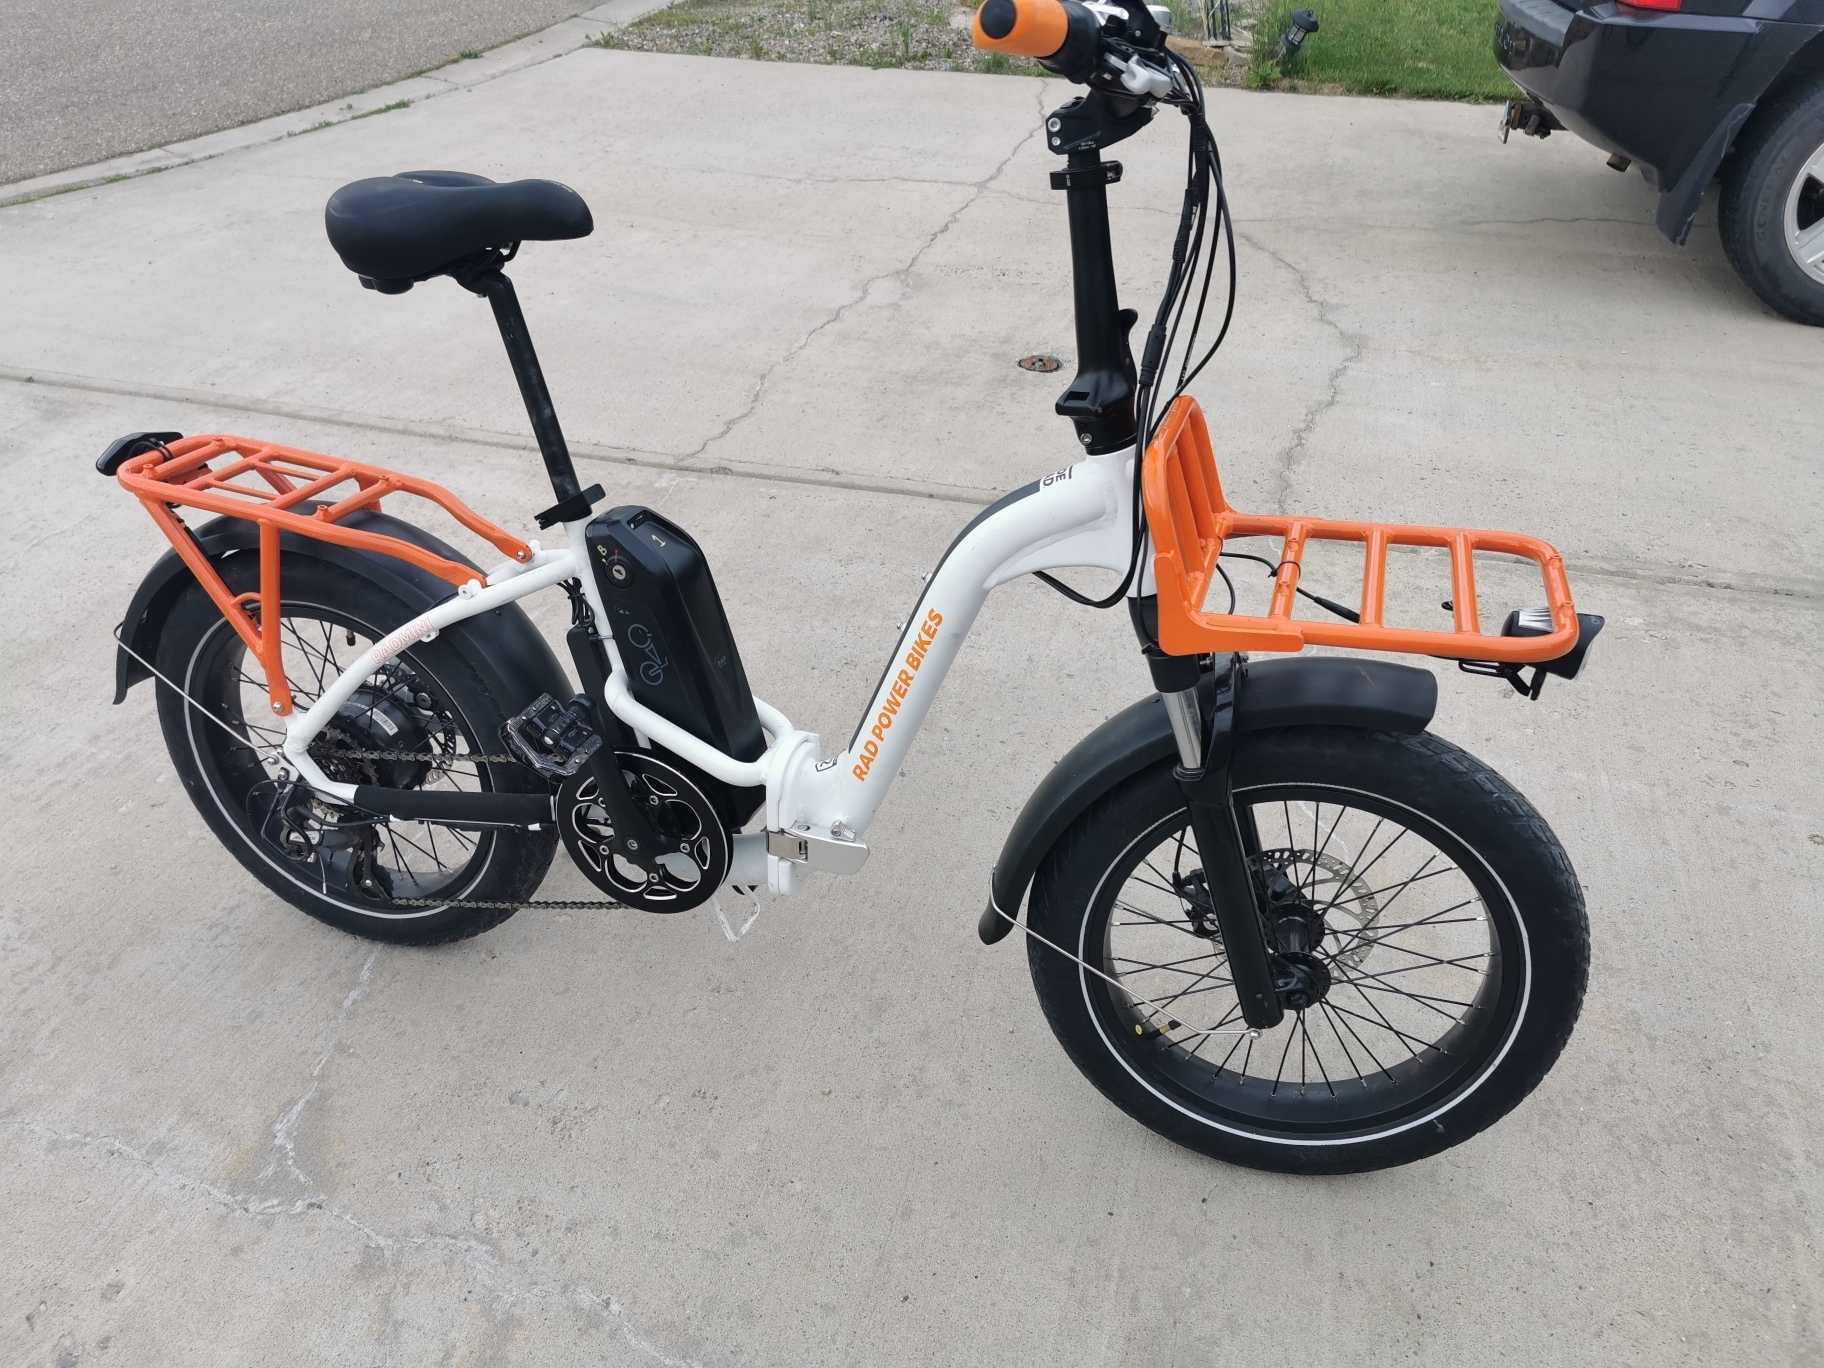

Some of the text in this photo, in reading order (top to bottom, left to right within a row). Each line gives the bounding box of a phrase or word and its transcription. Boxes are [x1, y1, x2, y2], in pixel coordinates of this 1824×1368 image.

[370, 617, 435, 665] RADMINI
[852, 607, 943, 782] RAD POWER BIKES
